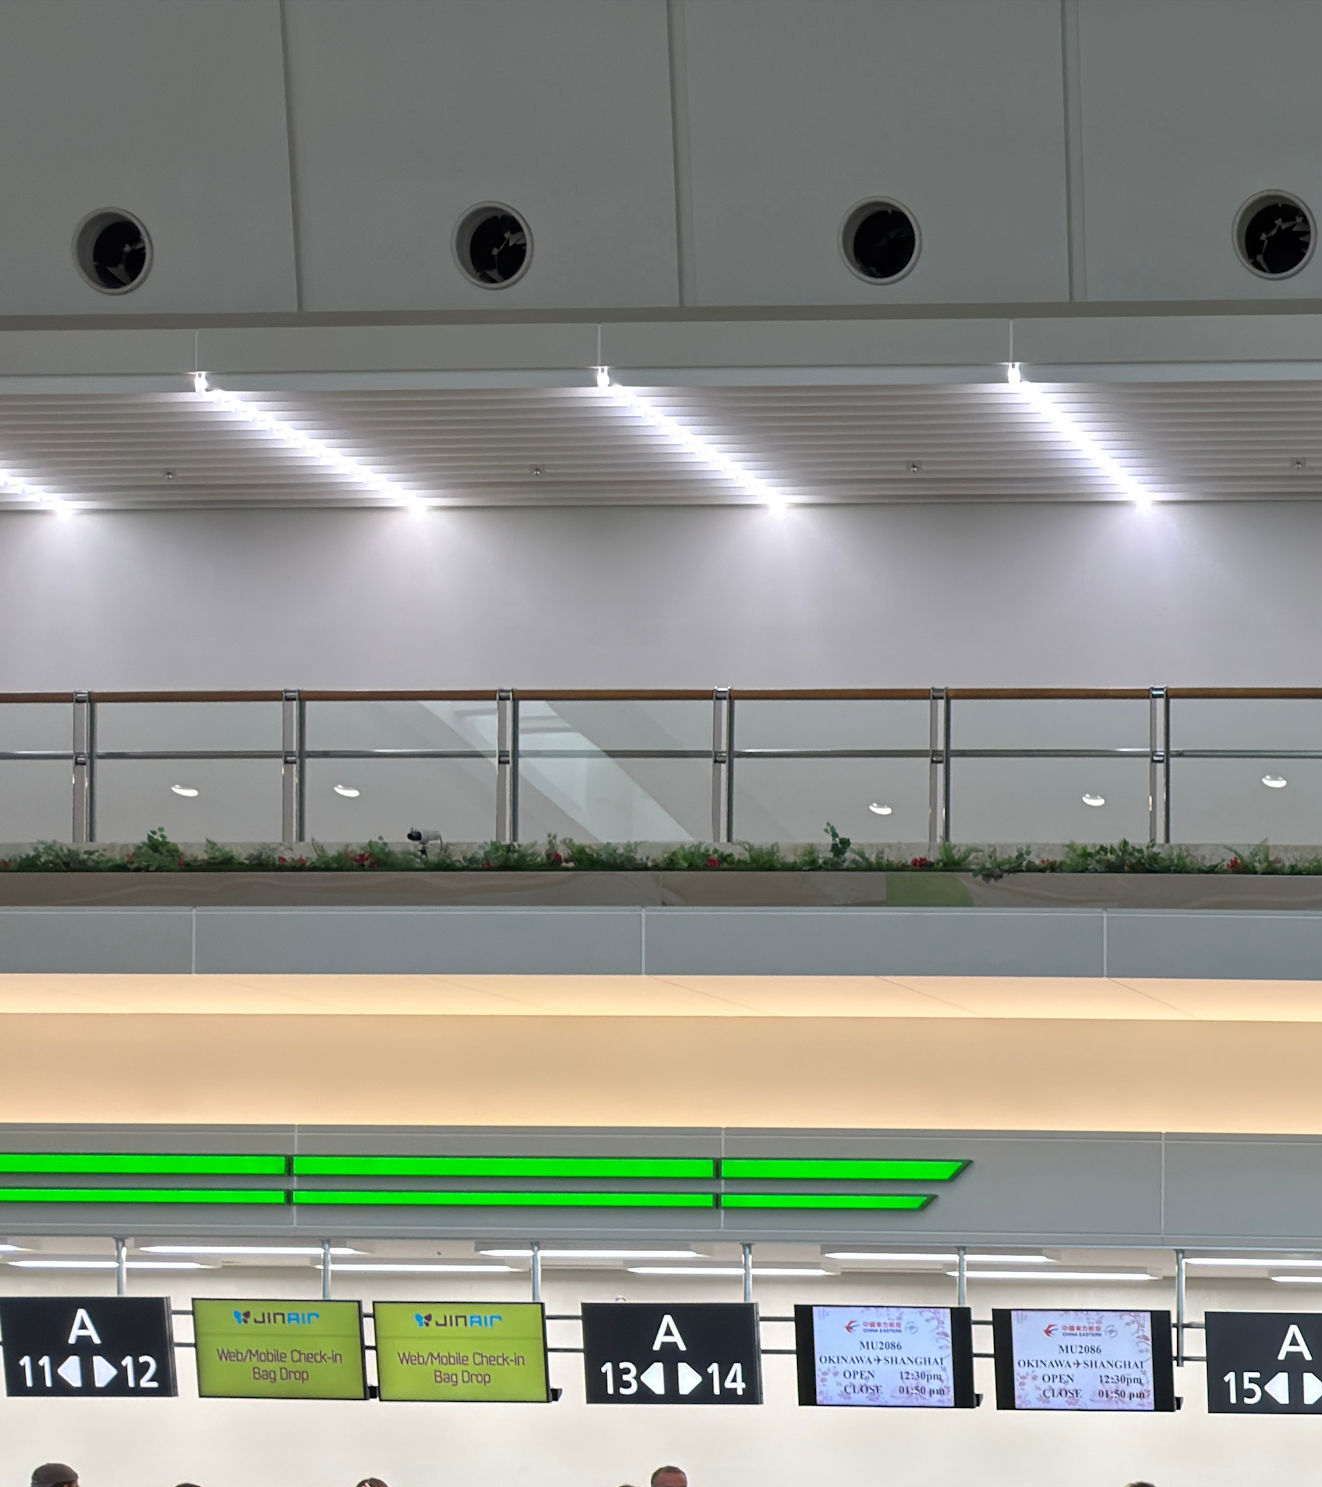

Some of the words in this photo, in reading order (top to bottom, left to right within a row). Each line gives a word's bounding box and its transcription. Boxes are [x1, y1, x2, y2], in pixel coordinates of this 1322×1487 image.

[68, 1309, 101, 1345] A
[653, 1315, 686, 1351] A
[860, 1342, 902, 1350] MU2086
[1059, 1345, 1101, 1354] MU2086
[1278, 1324, 1313, 1360] A
[217, 1349, 286, 1362] Web/Mobile
[291, 1349, 342, 1364] Check-in
[398, 1352, 468, 1366] Web/Mobile
[472, 1352, 525, 1367] Check-in
[820, 1356, 872, 1364] OKINAWA
[884, 1356, 944, 1365] SHANGHAI
[19, 1355, 52, 1387] 11
[121, 1355, 159, 1387] 12
[1018, 1360, 1072, 1368] OKINAWA
[1083, 1360, 1144, 1369] SHANGHAI
[253, 1367, 276, 1383] Bag
[280, 1367, 309, 1383] Drop
[434, 1371, 458, 1386] Bag
[462, 1371, 491, 1387] Drop
[601, 1362, 637, 1394] 13
[707, 1363, 746, 1395] 14
[844, 1370, 874, 1379] OPEN
[900, 1371, 941, 1382] 12:30pm
[1042, 1374, 1074, 1383] OPEN
[1100, 1375, 1142, 1386] 12:30pm
[844, 1385, 882, 1394] CLOSE
[899, 1386, 925, 1395] 01:50
[929, 1388, 945, 1397] pm
[1043, 1389, 1082, 1398] CLOSE
[1099, 1390, 1125, 1398] 01:50
[1129, 1391, 1145, 1400] pm
[1224, 1372, 1262, 1404] 15
